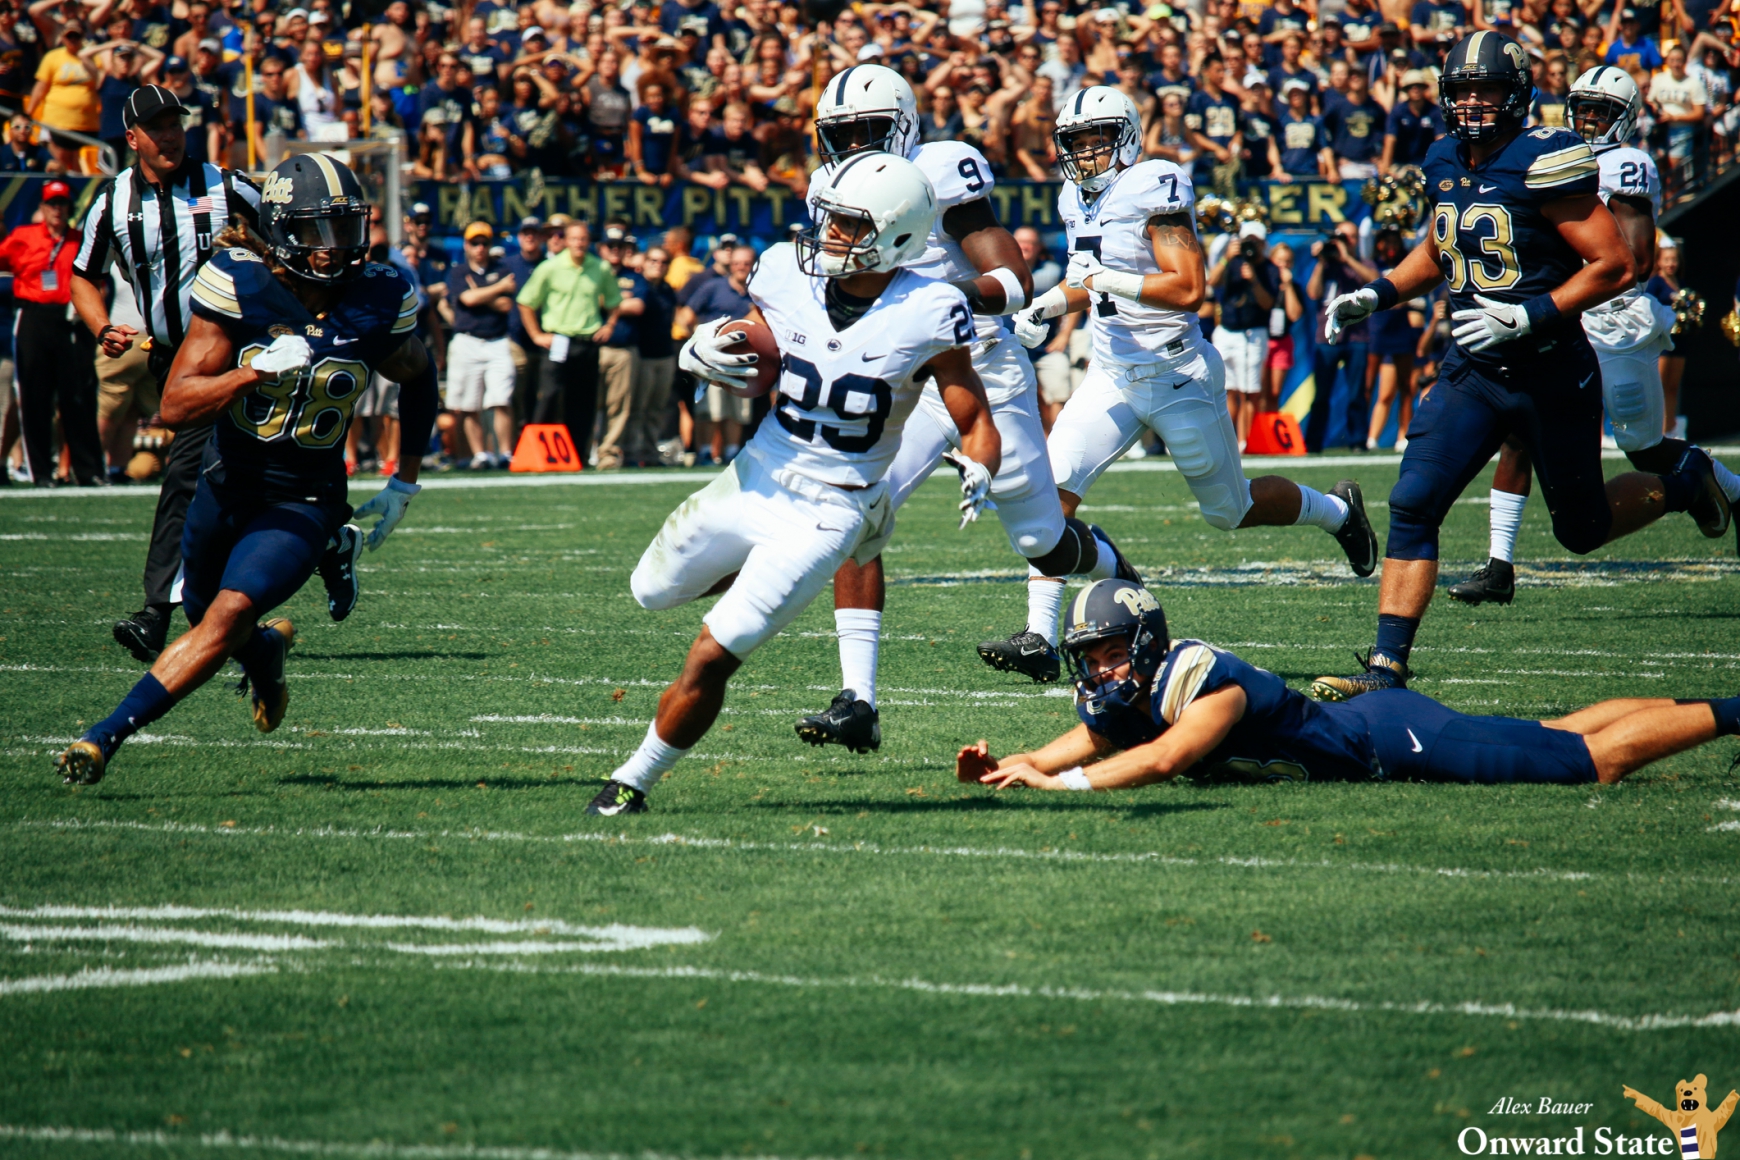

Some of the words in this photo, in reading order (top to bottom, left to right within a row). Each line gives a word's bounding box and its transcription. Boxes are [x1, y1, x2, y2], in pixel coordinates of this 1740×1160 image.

[261, 170, 294, 204] Pitt
[957, 157, 985, 192] 9
[1158, 173, 1180, 203] 7
[1620, 162, 1648, 189] 21
[439, 184, 664, 227] PANTHER
[683, 186, 792, 227] PITT
[197, 233, 211, 250] U
[1433, 202, 1522, 293] 83
[304, 324, 323, 337] Pitt
[229, 343, 369, 448] 38
[774, 352, 892, 453] 29
[539, 431, 570, 463] 10
[1274, 419, 1293, 449] G
